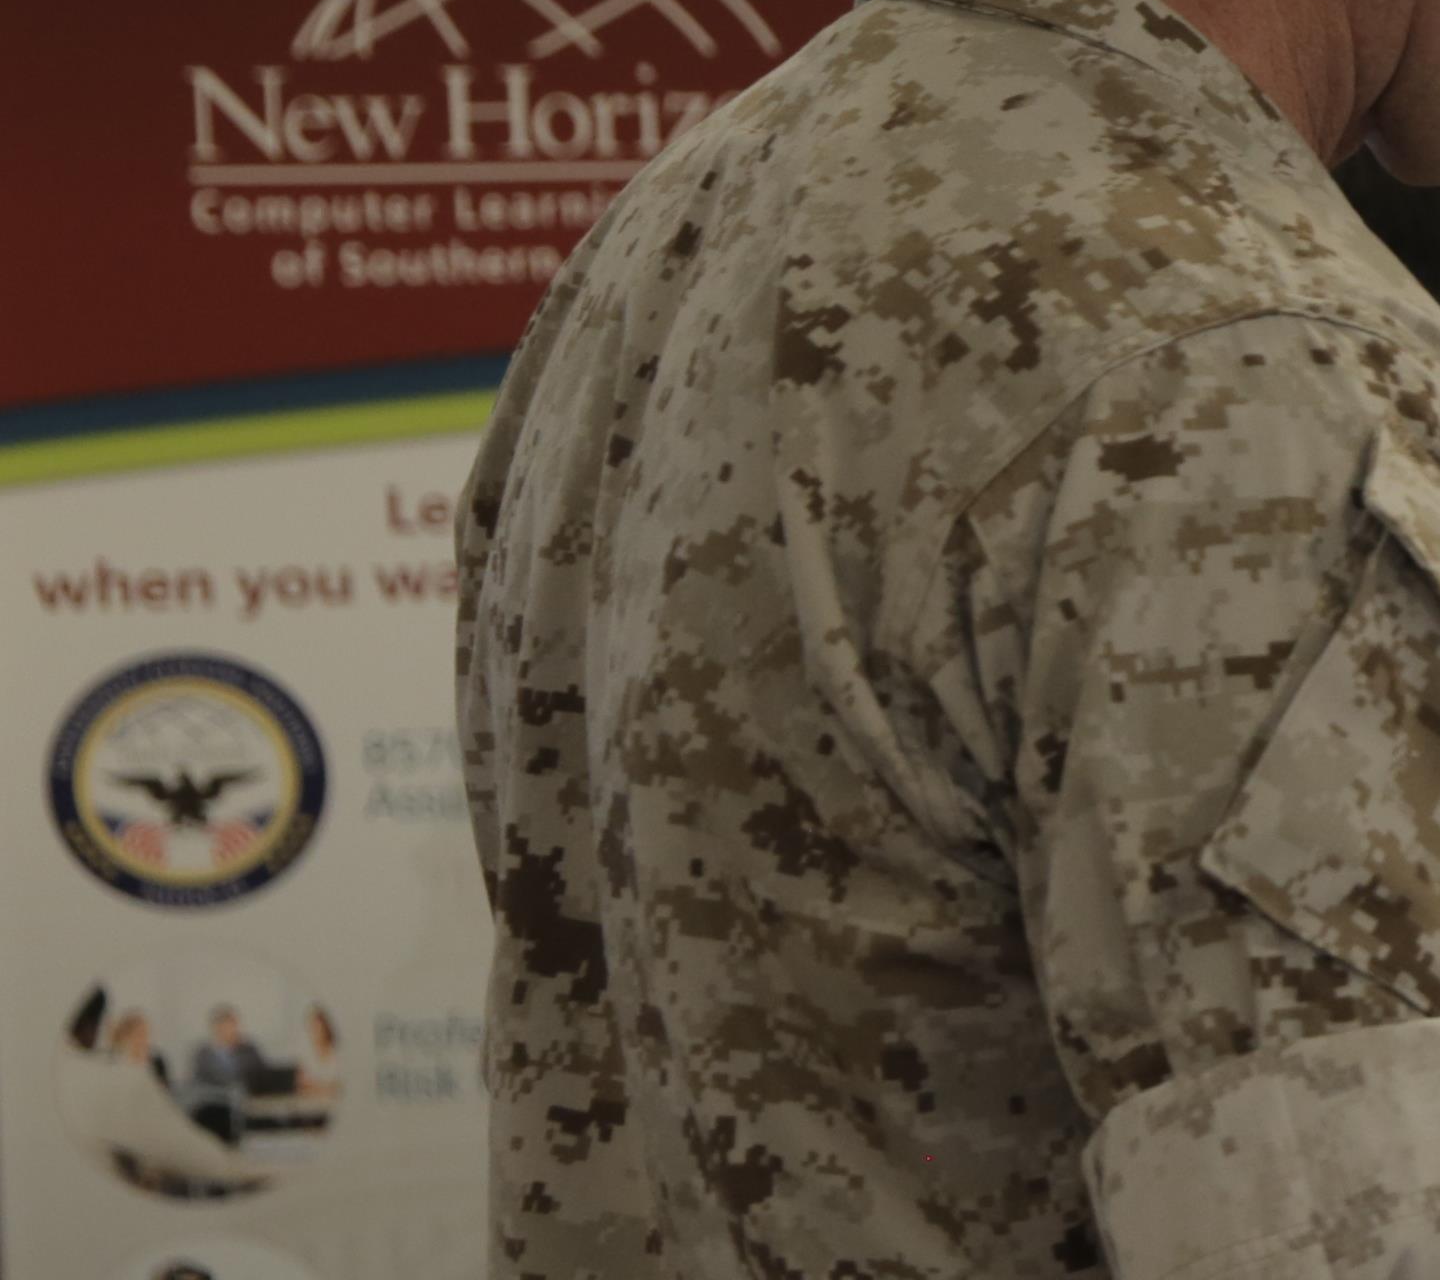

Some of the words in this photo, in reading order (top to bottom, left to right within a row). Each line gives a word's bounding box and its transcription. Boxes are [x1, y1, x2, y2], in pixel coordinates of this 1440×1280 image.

[184, 65, 425, 162] New
[443, 62, 735, 161] Horiz
[191, 188, 433, 236] Computer
[273, 245, 324, 289] of
[341, 242, 563, 287] Southern
[34, 557, 213, 612] when
[235, 565, 353, 624] you
